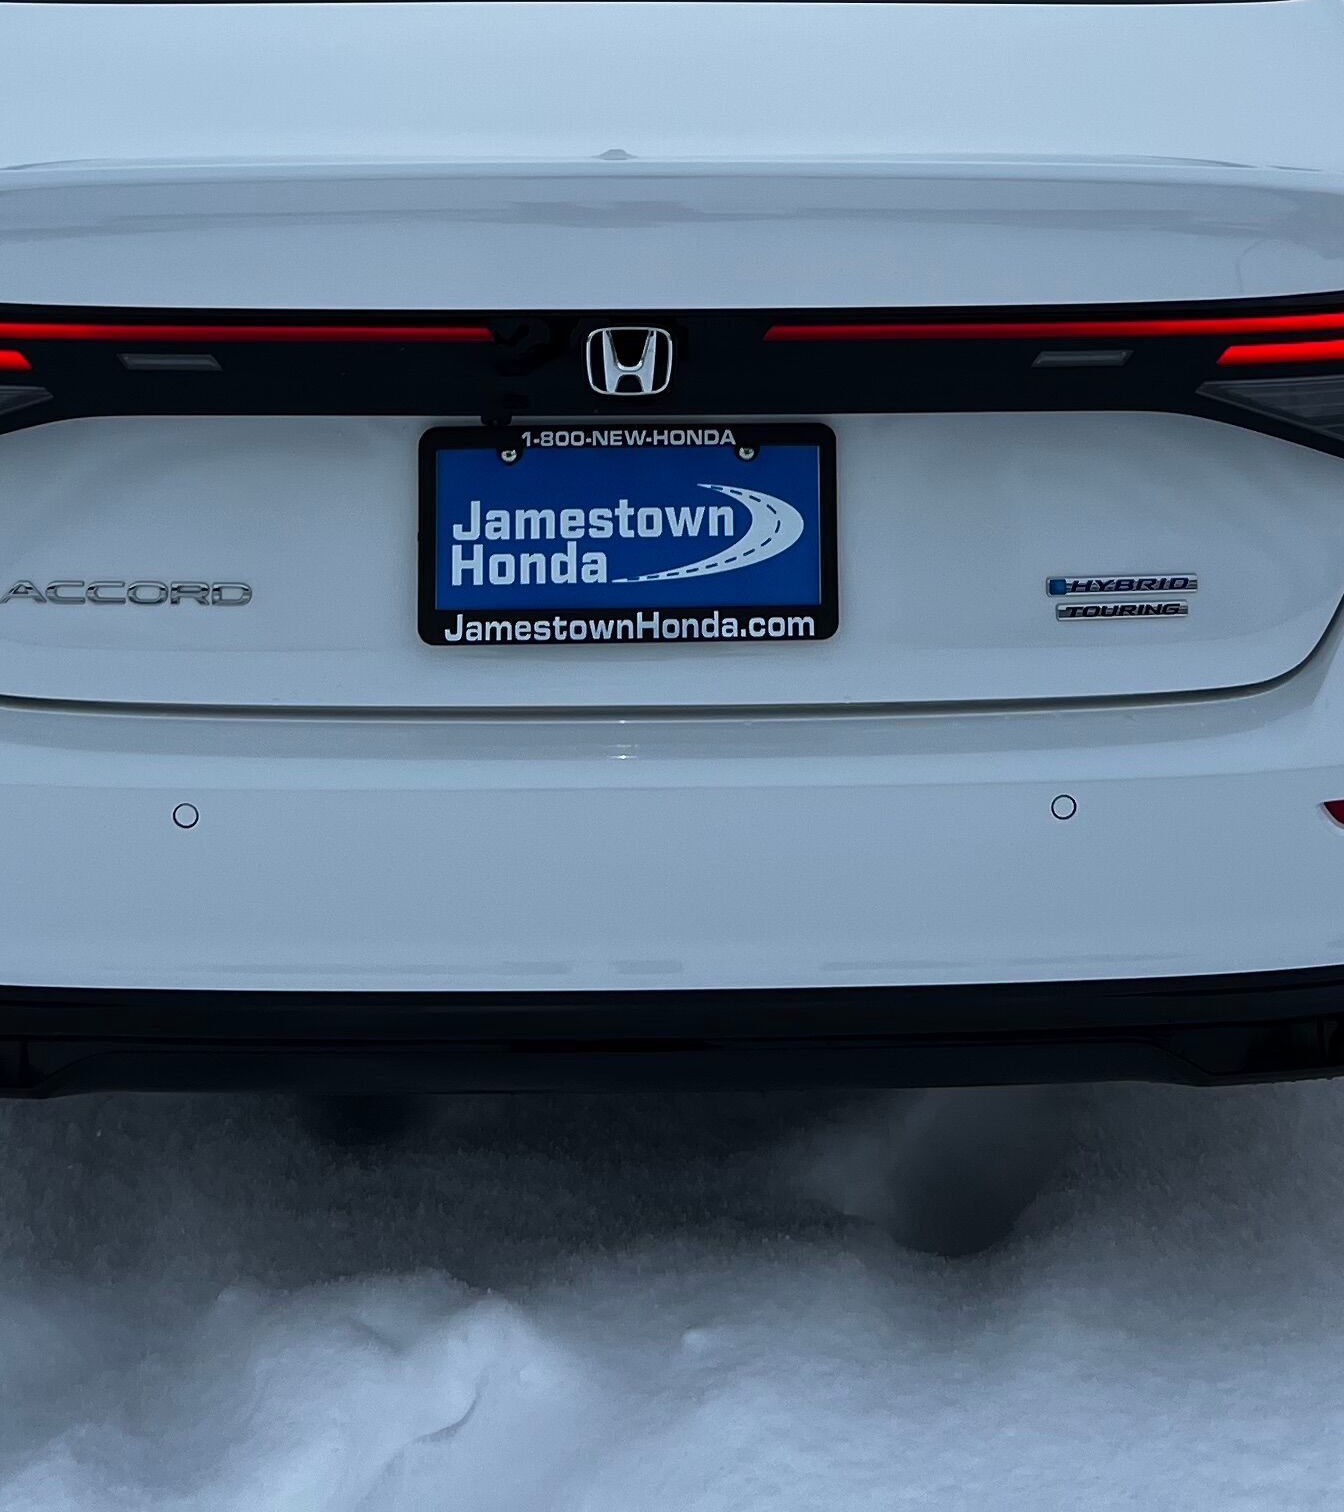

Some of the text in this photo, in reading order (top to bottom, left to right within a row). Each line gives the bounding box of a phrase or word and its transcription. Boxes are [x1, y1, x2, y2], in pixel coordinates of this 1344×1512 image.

[520, 428, 737, 448] 1-800-NEW-HONDA
[452, 499, 734, 541] Jamestown
[451, 541, 608, 586] Honda
[0, 579, 253, 606] ACCORD
[1070, 577, 1190, 593] HYBRID
[1065, 603, 1182, 618] TOURING
[444, 610, 816, 642] JamestownHonda.com
